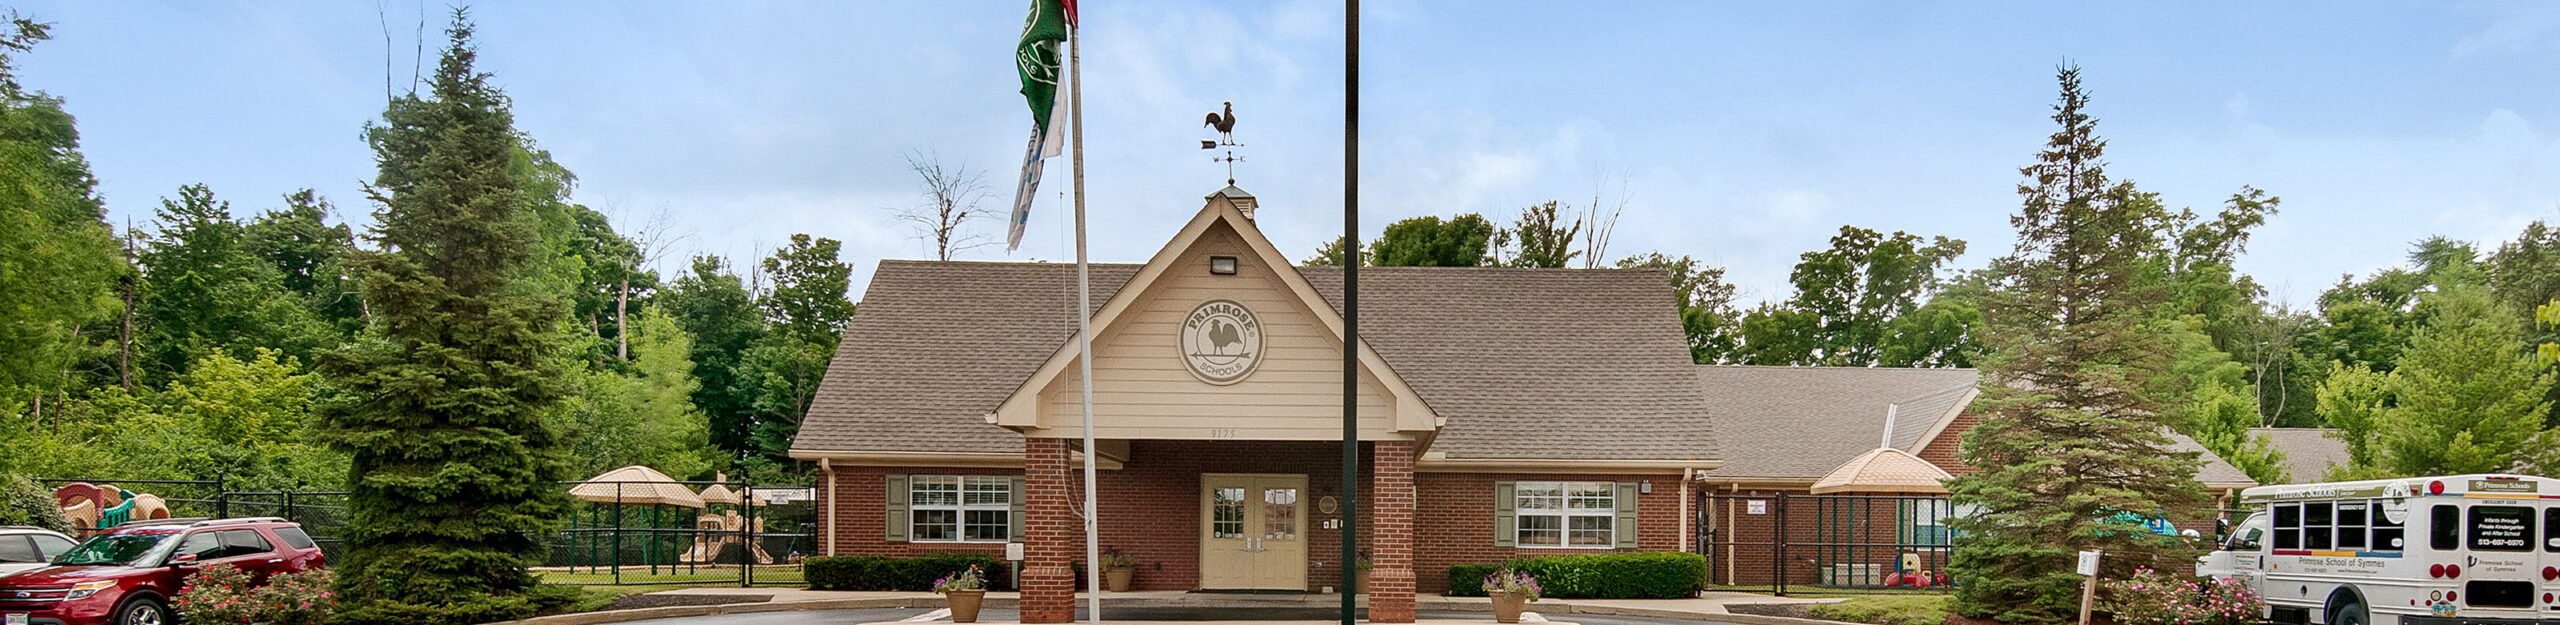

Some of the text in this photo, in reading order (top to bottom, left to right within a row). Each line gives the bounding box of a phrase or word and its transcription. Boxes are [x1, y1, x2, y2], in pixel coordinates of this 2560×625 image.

[1188, 304, 1255, 331] PRIMROSE
[1199, 362, 1243, 376] SCHOOLS
[1211, 429, 1235, 438] 9175
[2299, 557, 2385, 568] Primrose School of Symmes
